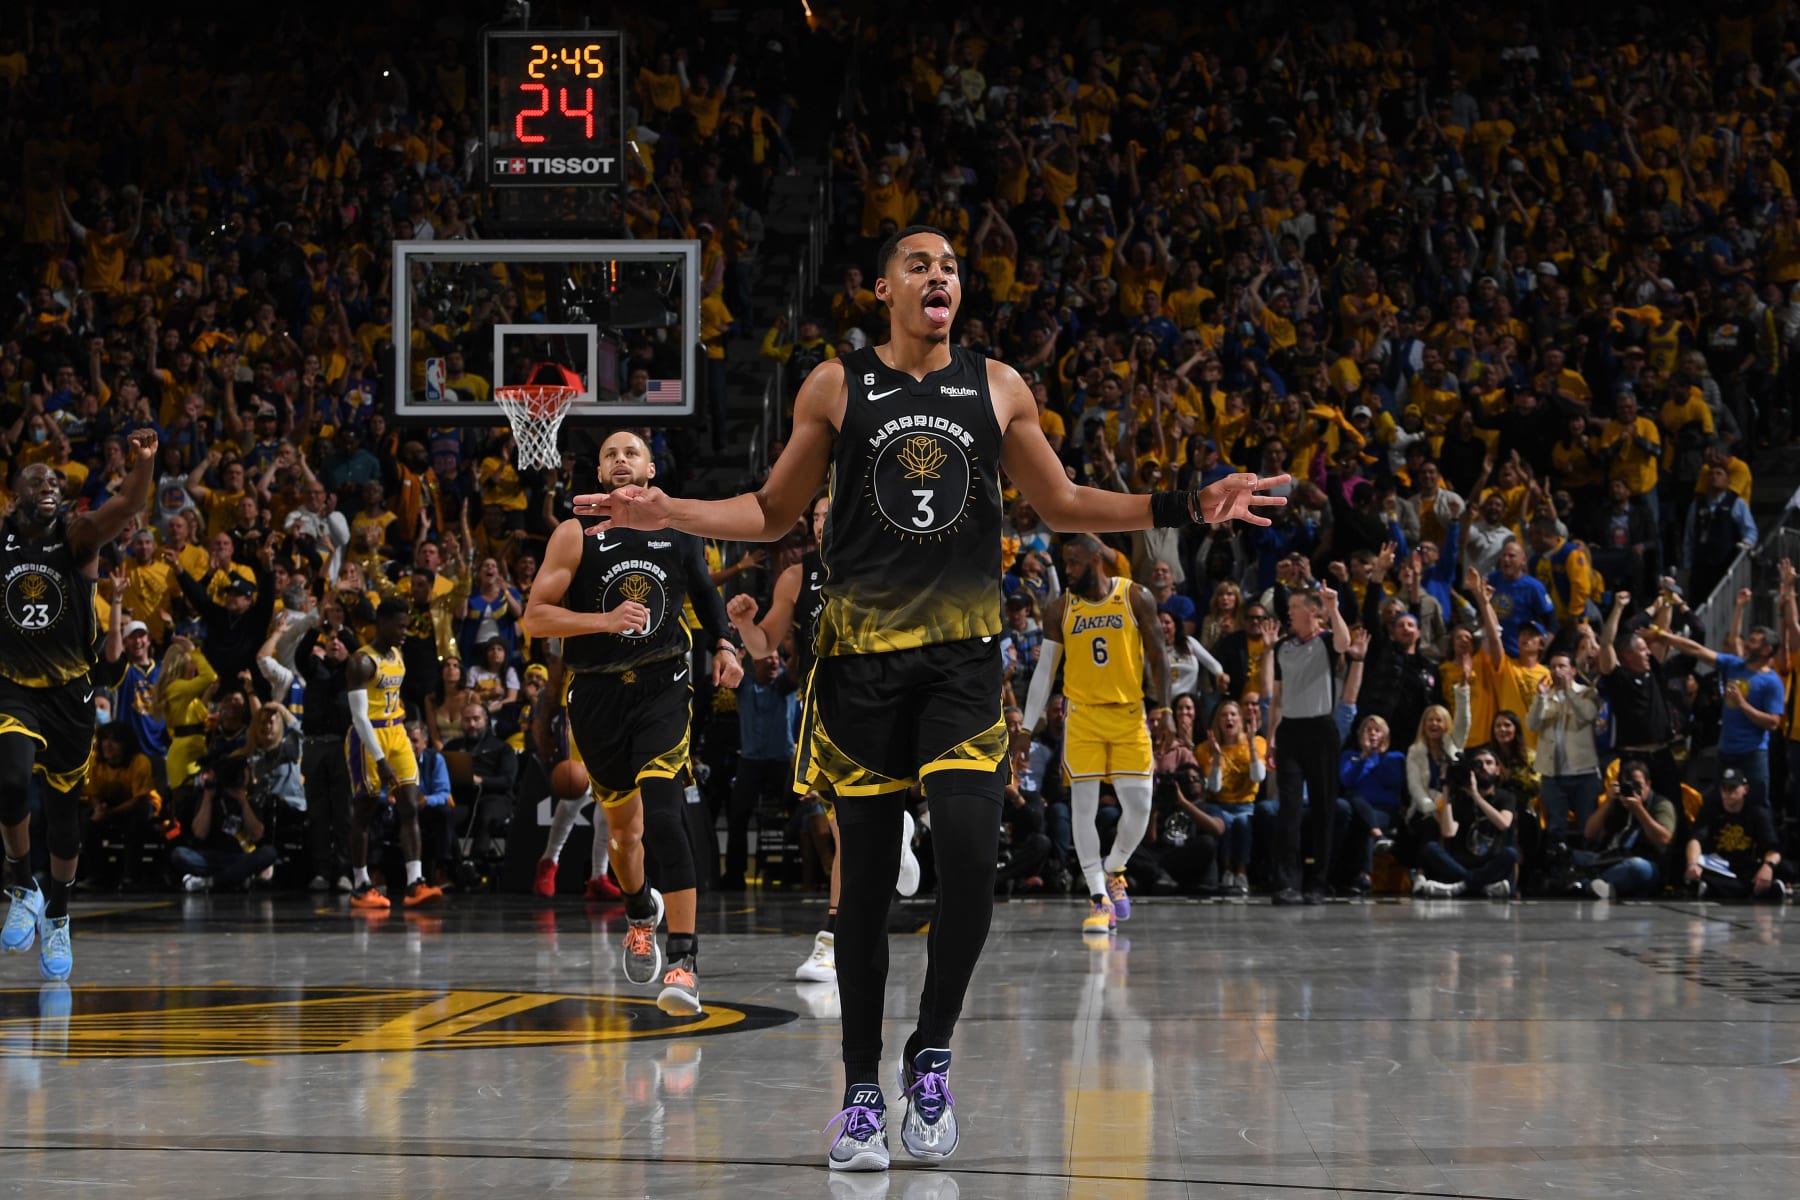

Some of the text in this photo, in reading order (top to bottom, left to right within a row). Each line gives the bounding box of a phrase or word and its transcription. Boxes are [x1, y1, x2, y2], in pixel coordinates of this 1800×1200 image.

[528, 44, 604, 79] 2:45
[515, 83, 594, 143] 24
[527, 157, 615, 174] TISSOT
[863, 373, 875, 386] 6
[940, 385, 978, 397] Rakuten
[868, 415, 975, 448] WARRIORS
[911, 489, 935, 528] 3
[4, 563, 62, 581] WARRIORS
[601, 560, 668, 583] WARRIORS
[21, 604, 49, 627] 23
[1070, 614, 1123, 636] LAKERS
[1091, 636, 1109, 668] 6
